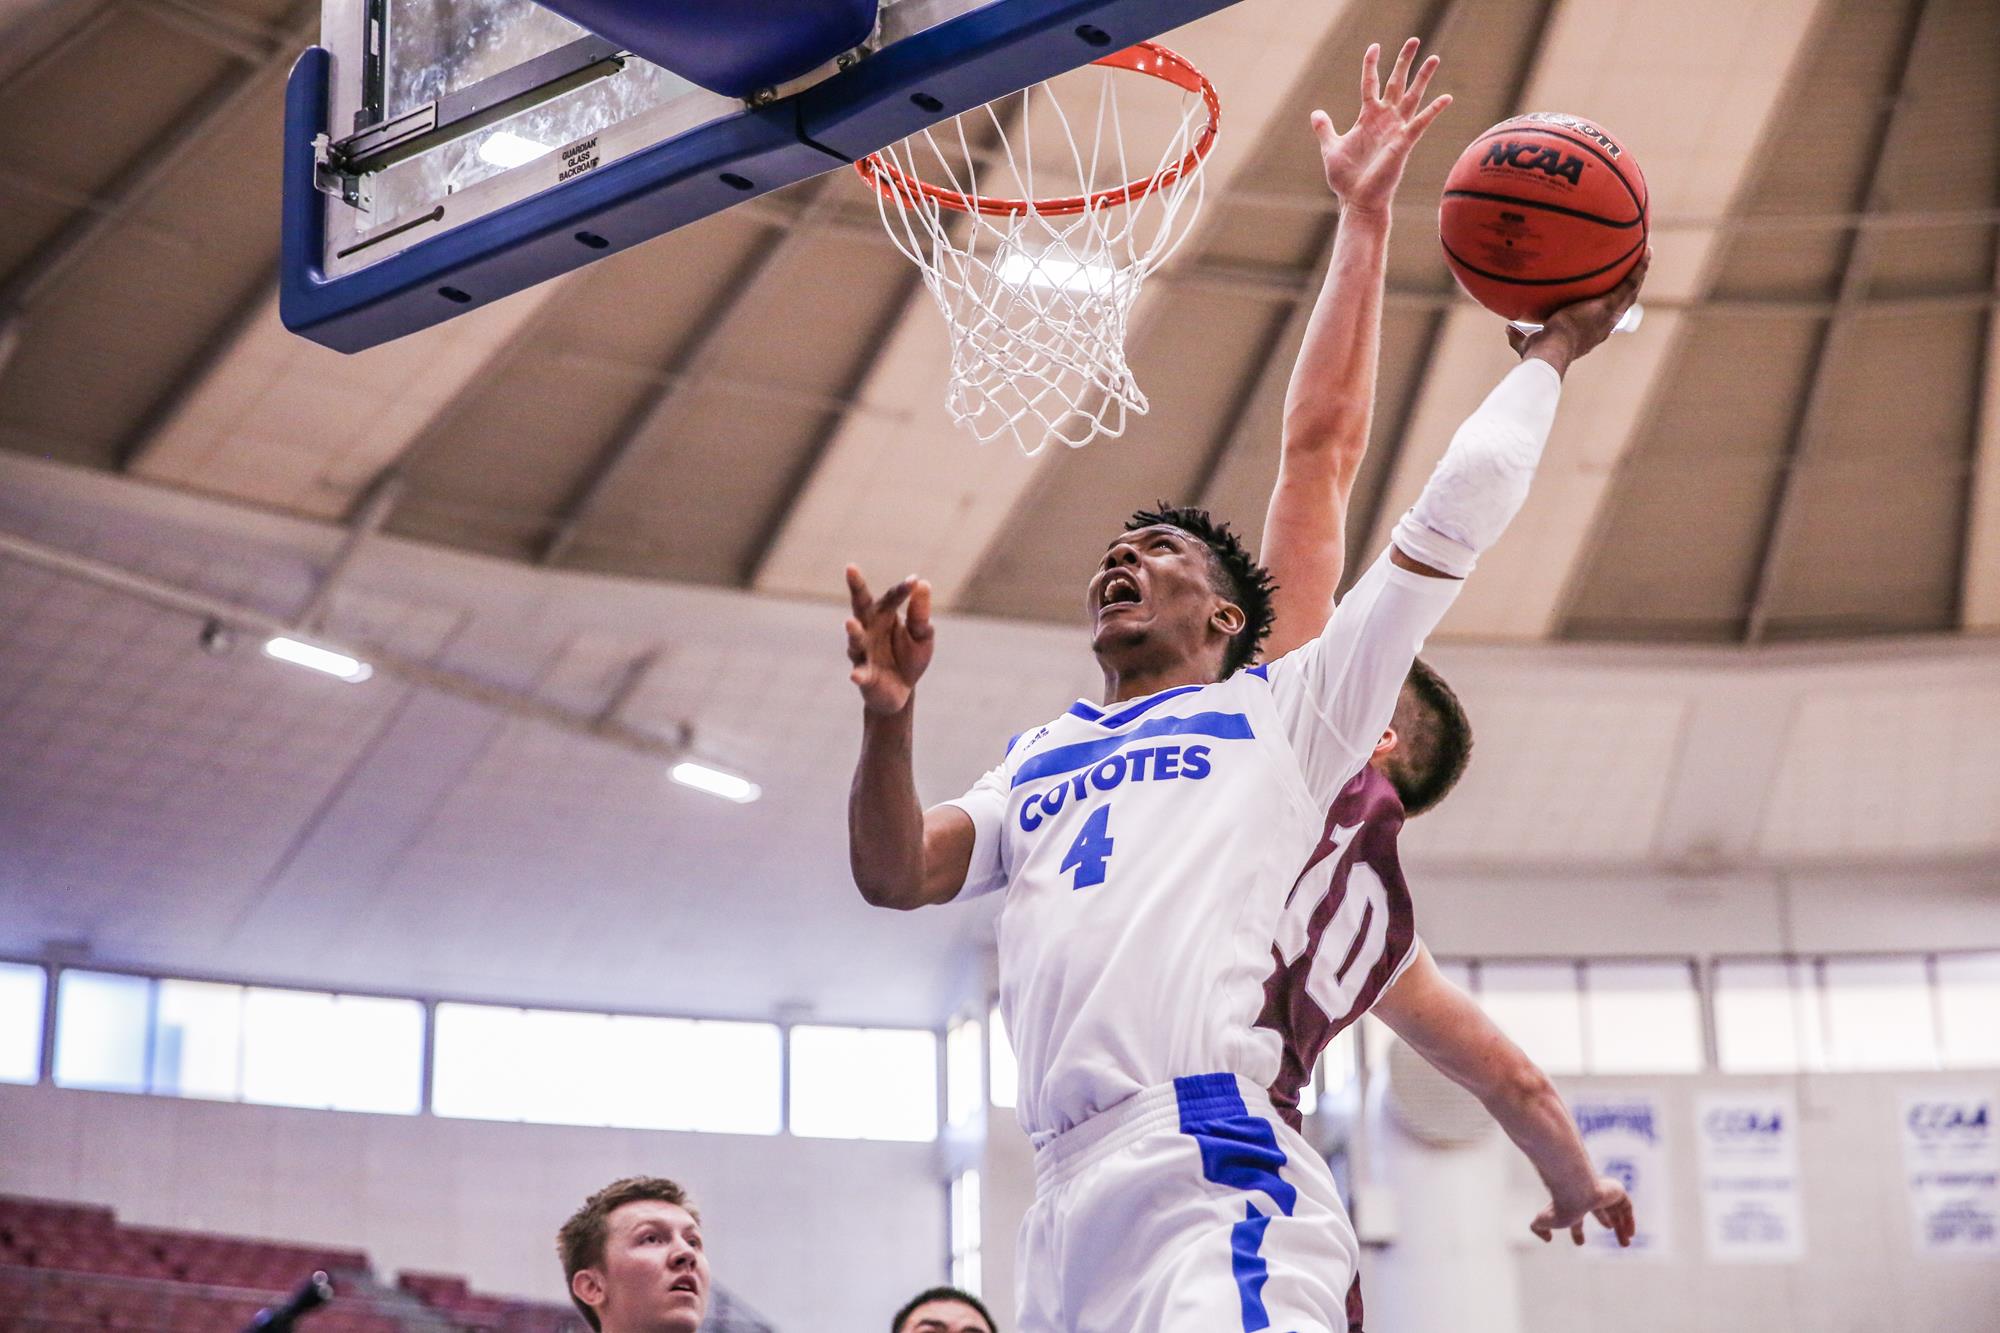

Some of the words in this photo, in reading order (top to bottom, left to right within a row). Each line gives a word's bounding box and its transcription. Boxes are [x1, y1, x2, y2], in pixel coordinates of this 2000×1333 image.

[562, 137, 597, 160] GUARDIAN
[568, 151, 590, 167] GLASS
[1480, 143, 1584, 186] NCAA
[1019, 744, 1212, 832] COYOTES
[1059, 802, 1114, 891] 4
